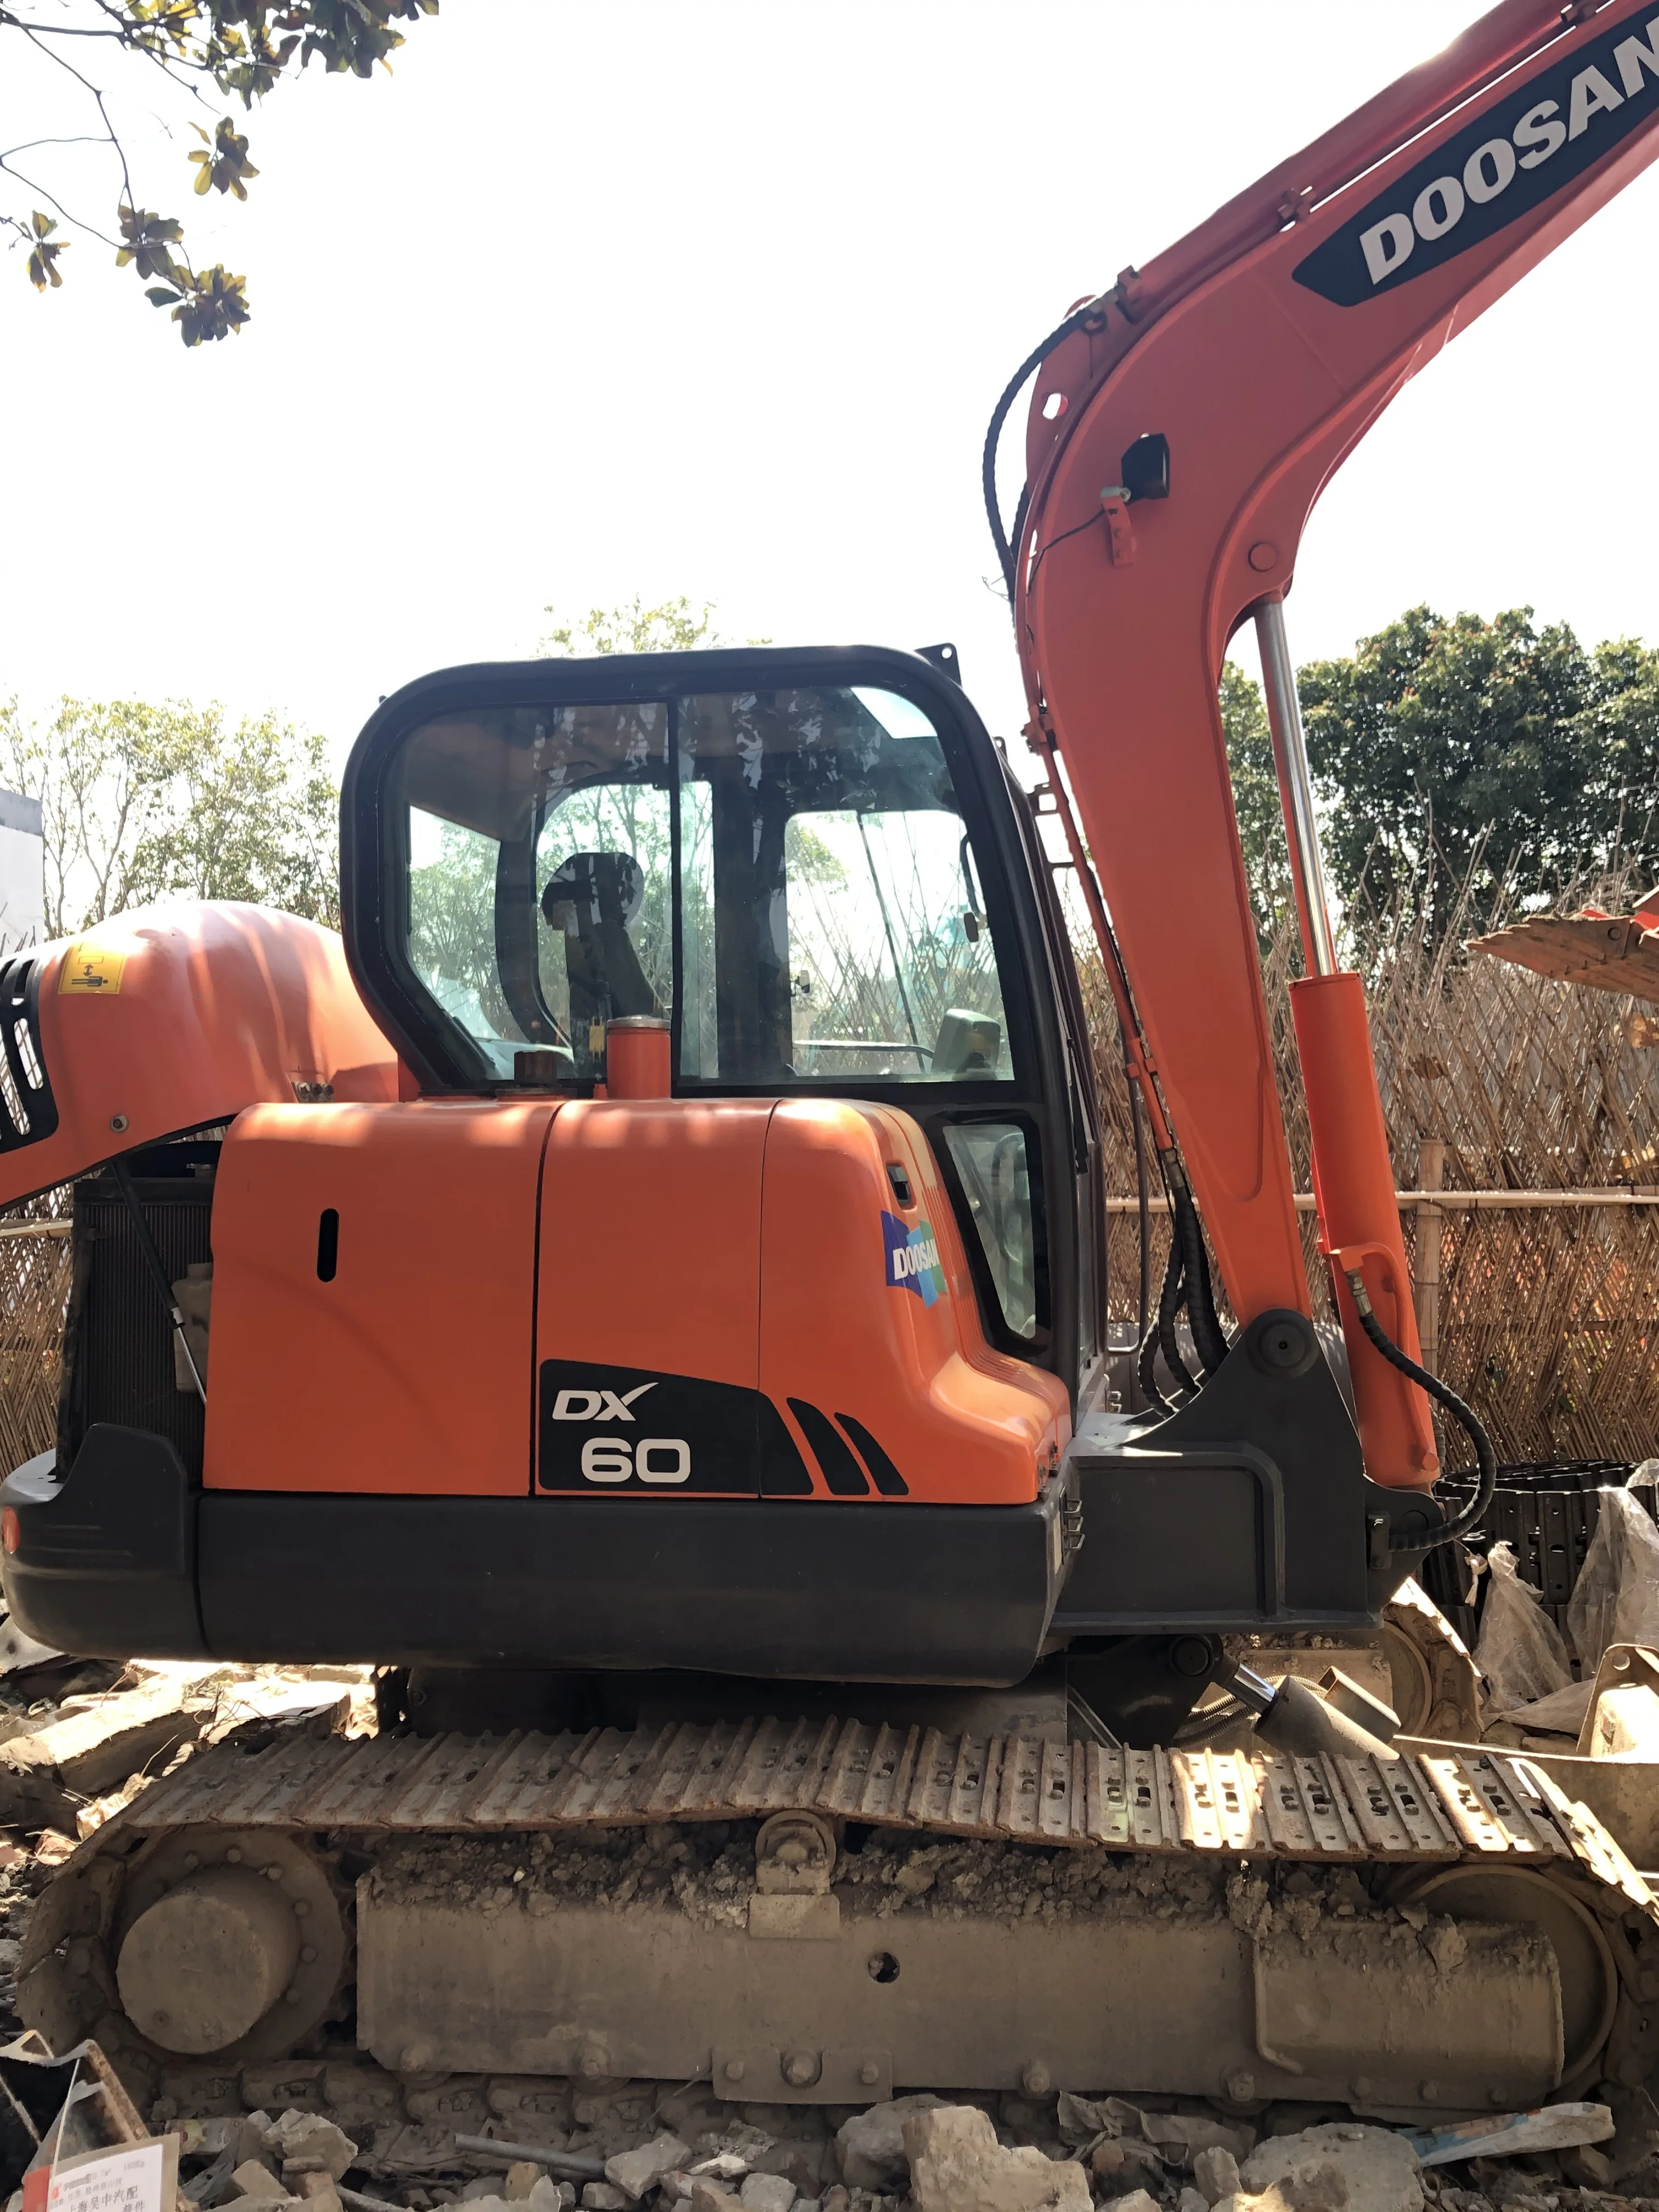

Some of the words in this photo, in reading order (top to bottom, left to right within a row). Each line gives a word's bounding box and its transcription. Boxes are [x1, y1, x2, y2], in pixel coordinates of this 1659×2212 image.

[1358, 15, 1659, 285] DOOSAN
[893, 1238, 940, 1280] DOOSAN
[552, 1382, 658, 1421] DX
[581, 1437, 691, 1483] 60
